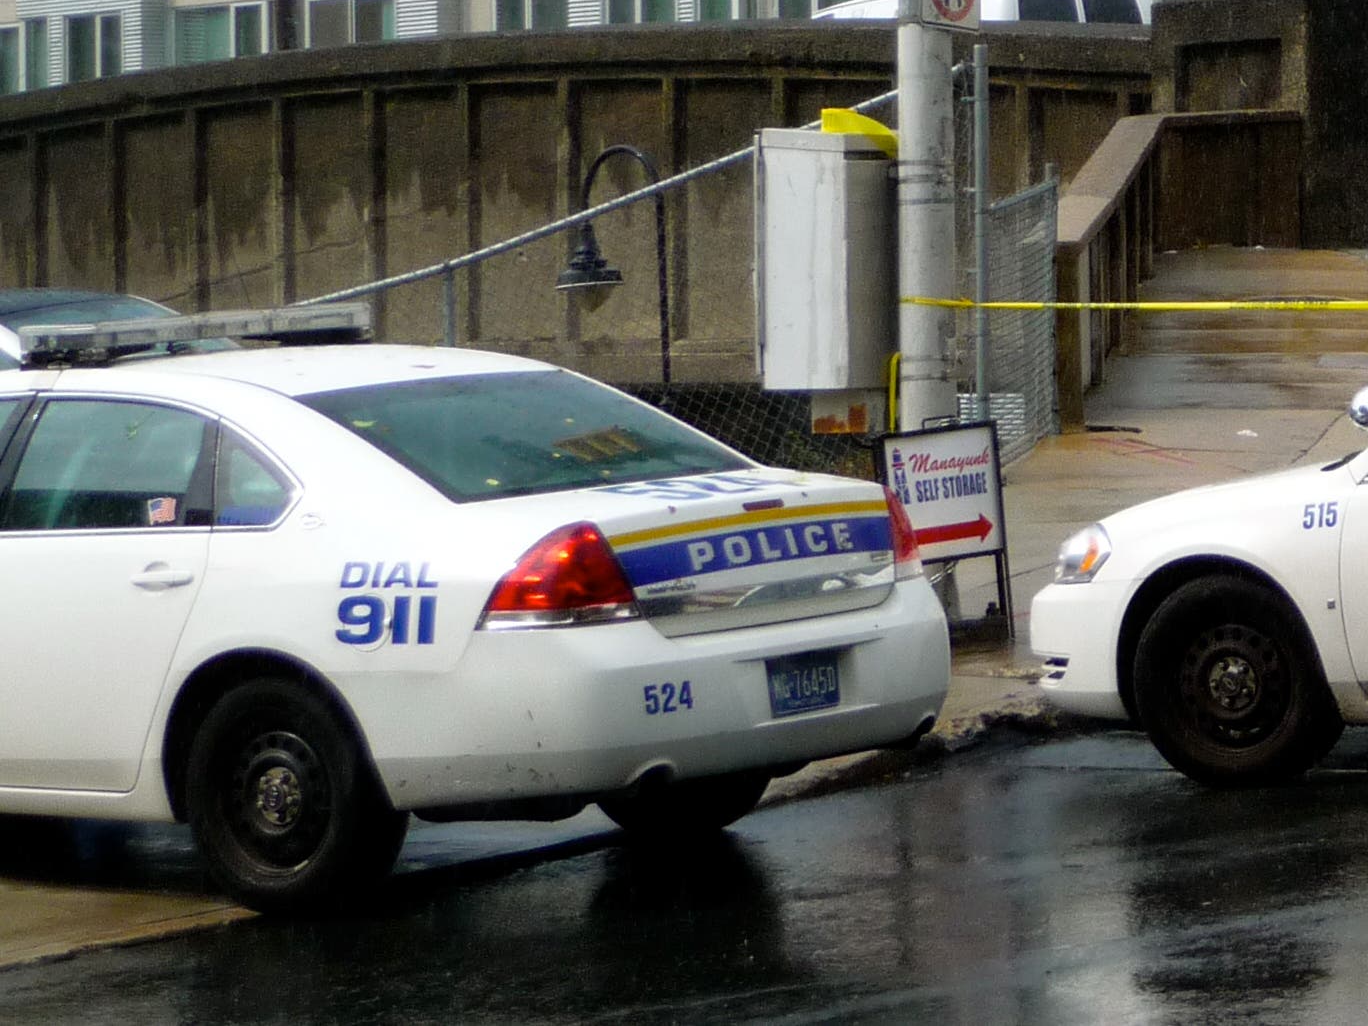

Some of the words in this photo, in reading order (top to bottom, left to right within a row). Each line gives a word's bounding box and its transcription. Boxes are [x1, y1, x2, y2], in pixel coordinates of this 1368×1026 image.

[909, 446, 989, 473] Manayunk
[915, 477, 940, 503] SELF
[942, 471, 988, 499] STORAGE
[1302, 501, 1338, 530] 515
[687, 521, 853, 571] POLICE
[340, 561, 438, 588] DIAL
[335, 594, 436, 645] 911
[644, 681, 694, 715] 524
